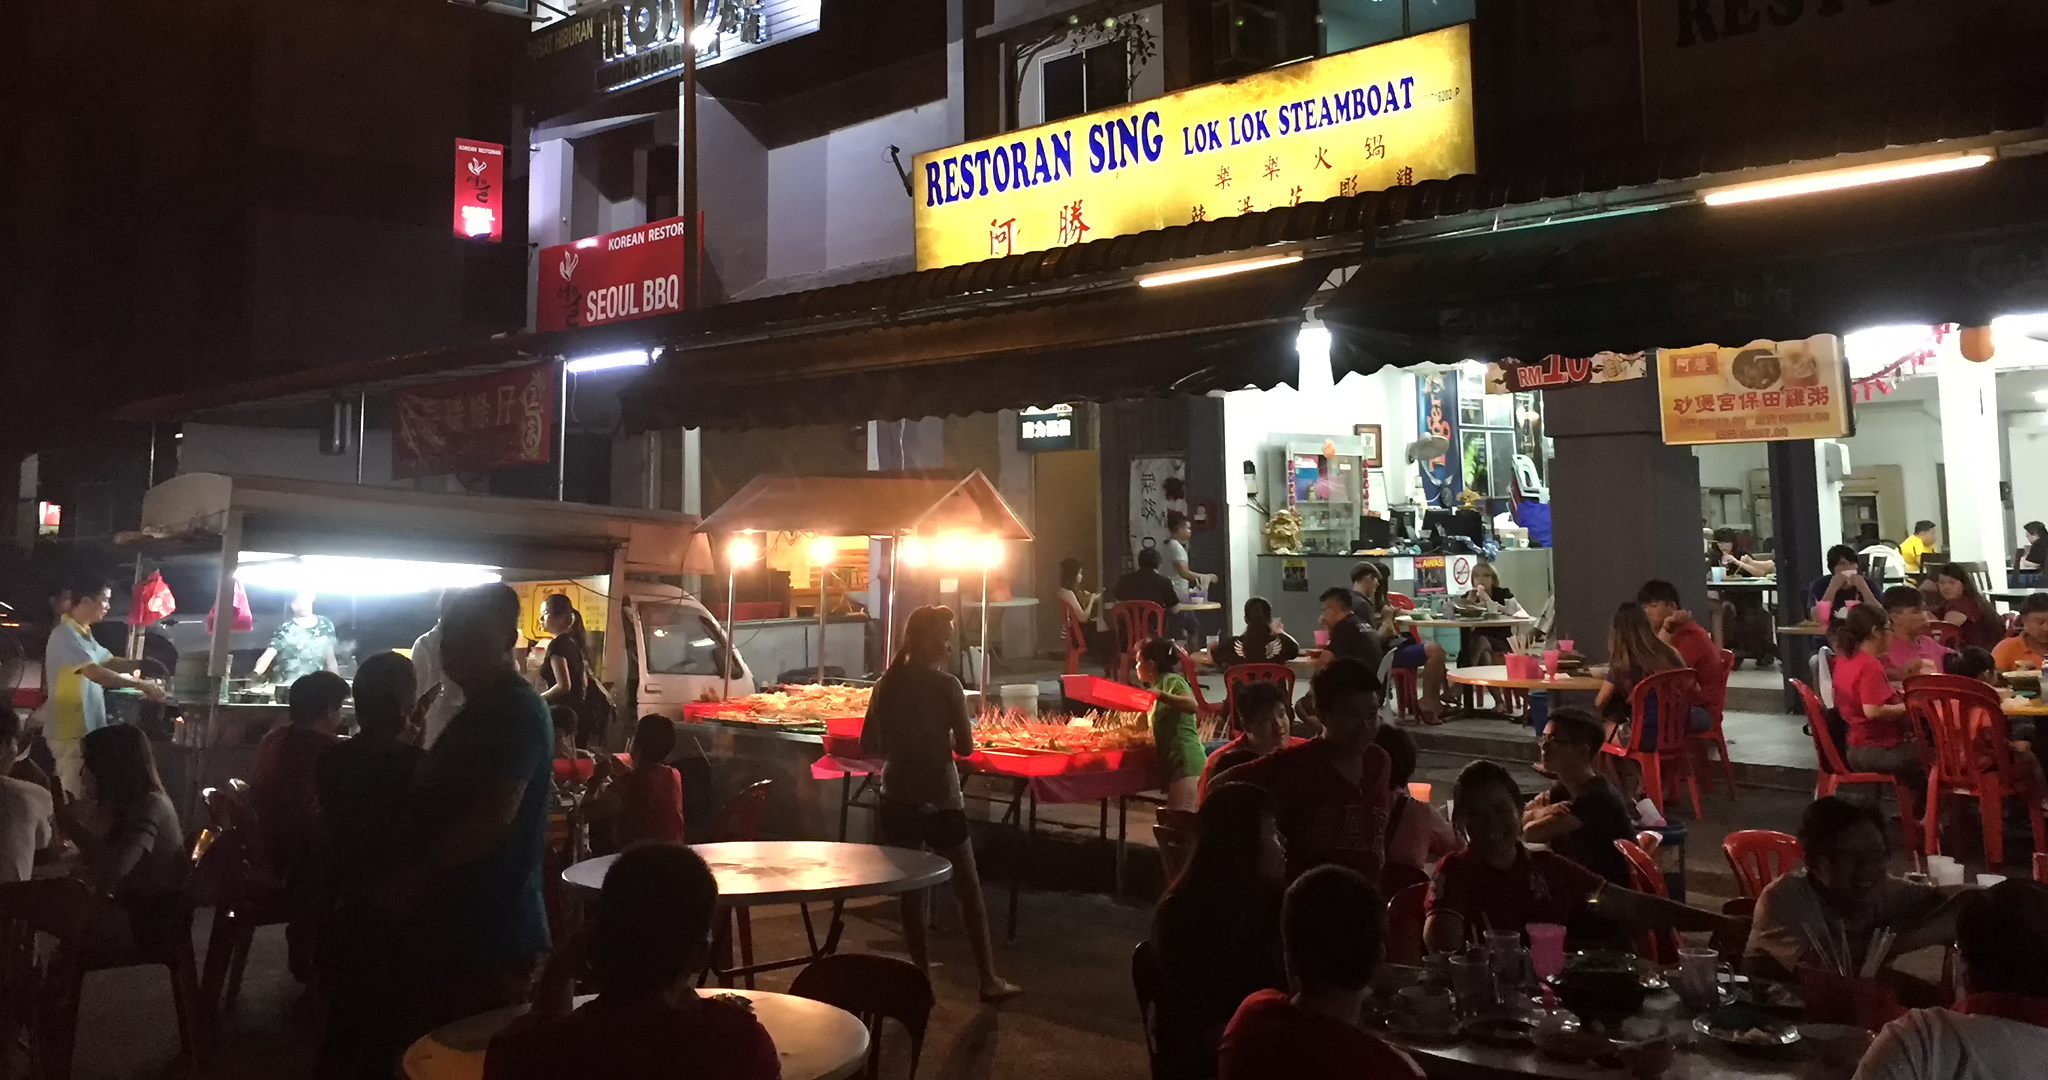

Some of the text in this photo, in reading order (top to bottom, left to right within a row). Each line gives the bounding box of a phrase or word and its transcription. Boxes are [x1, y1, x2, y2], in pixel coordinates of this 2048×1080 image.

[554, 17, 594, 52] HIBURAN
[925, 76, 1415, 207] RESTORAN SING LOK LOK STEAMBOAT
[608, 222, 684, 251] KOREAN RESTOR
[586, 273, 679, 323] SEOUL BBQ
[1516, 353, 1591, 388] RM10
[1673, 386, 1829, 415] 砂煲宮保田雞粥
[1427, 394, 1452, 472] Tger
